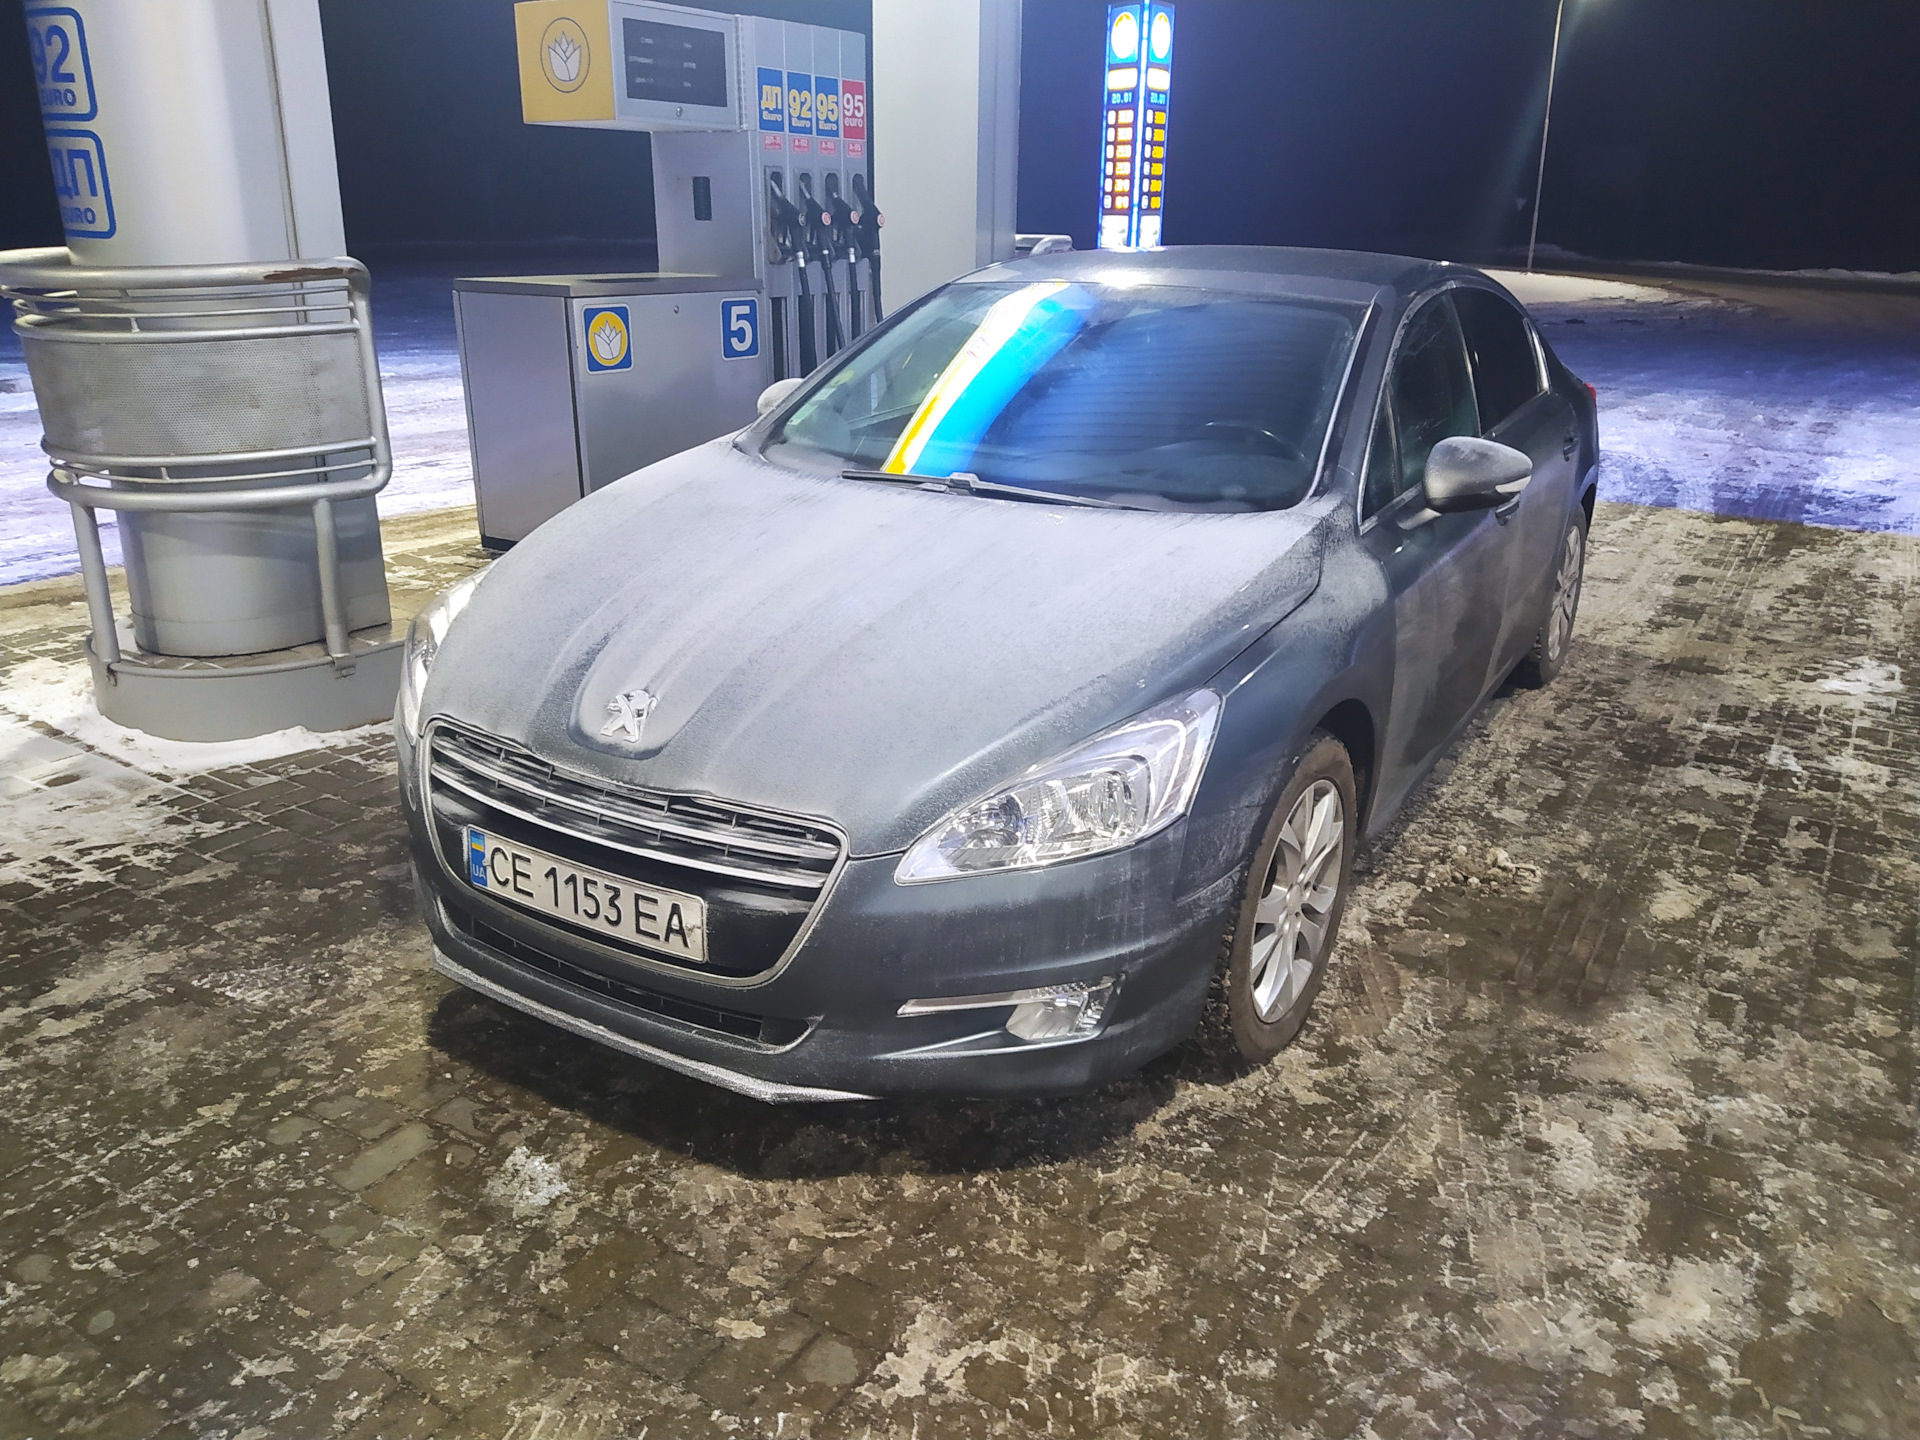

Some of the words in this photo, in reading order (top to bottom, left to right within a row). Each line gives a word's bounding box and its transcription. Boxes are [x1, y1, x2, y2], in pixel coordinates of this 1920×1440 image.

[30, 25, 76, 84] 92
[761, 85, 782, 110] ДП
[789, 89, 811, 118] 92
[816, 93, 838, 122] 95
[843, 93, 864, 118] 95
[730, 305, 753, 352] 5
[472, 863, 486, 880] UA
[490, 846, 534, 898] CE
[544, 866, 622, 927] 1153
[634, 891, 690, 949] EA
